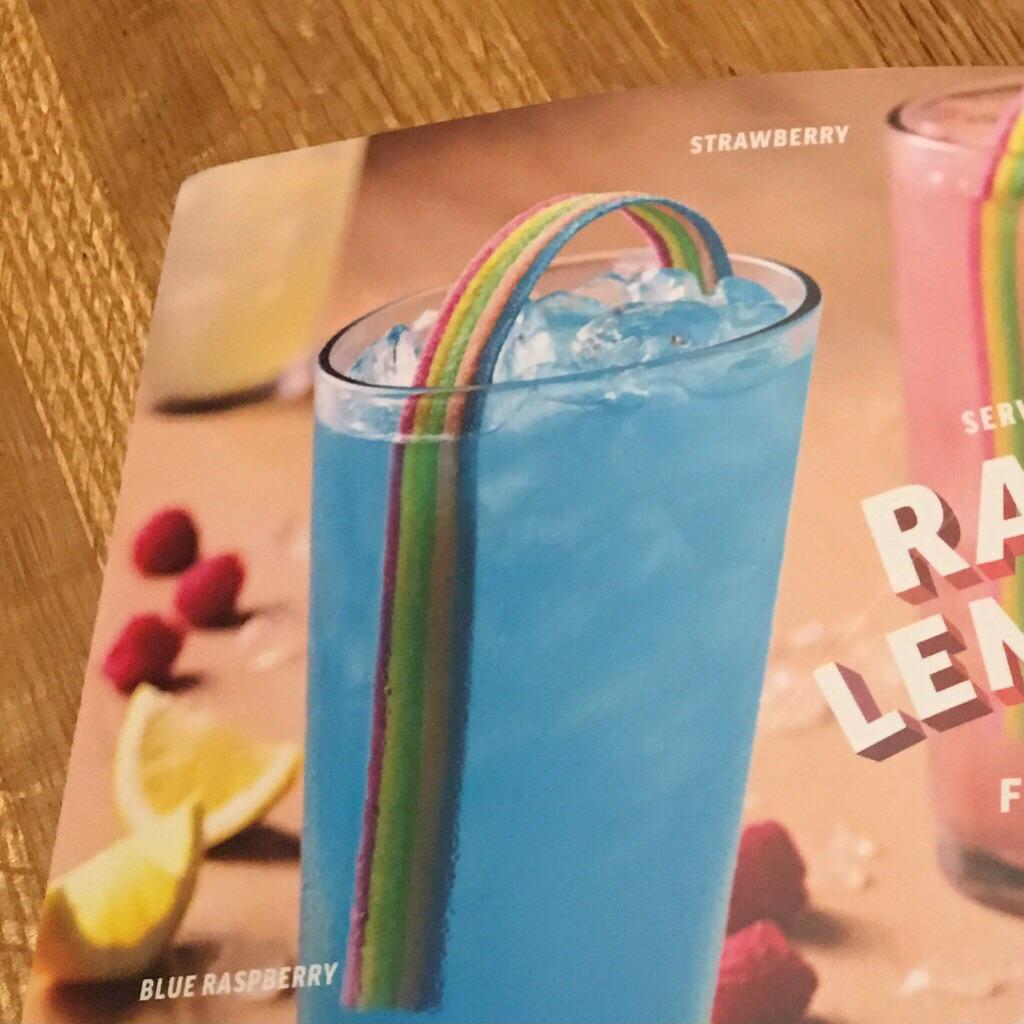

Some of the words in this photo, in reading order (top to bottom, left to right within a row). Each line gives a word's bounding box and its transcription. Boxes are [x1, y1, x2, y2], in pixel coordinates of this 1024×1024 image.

[690, 125, 850, 154] STRAWBERRY
[139, 975, 198, 1001] BLUE
[201, 962, 339, 997] RASPBERRY
